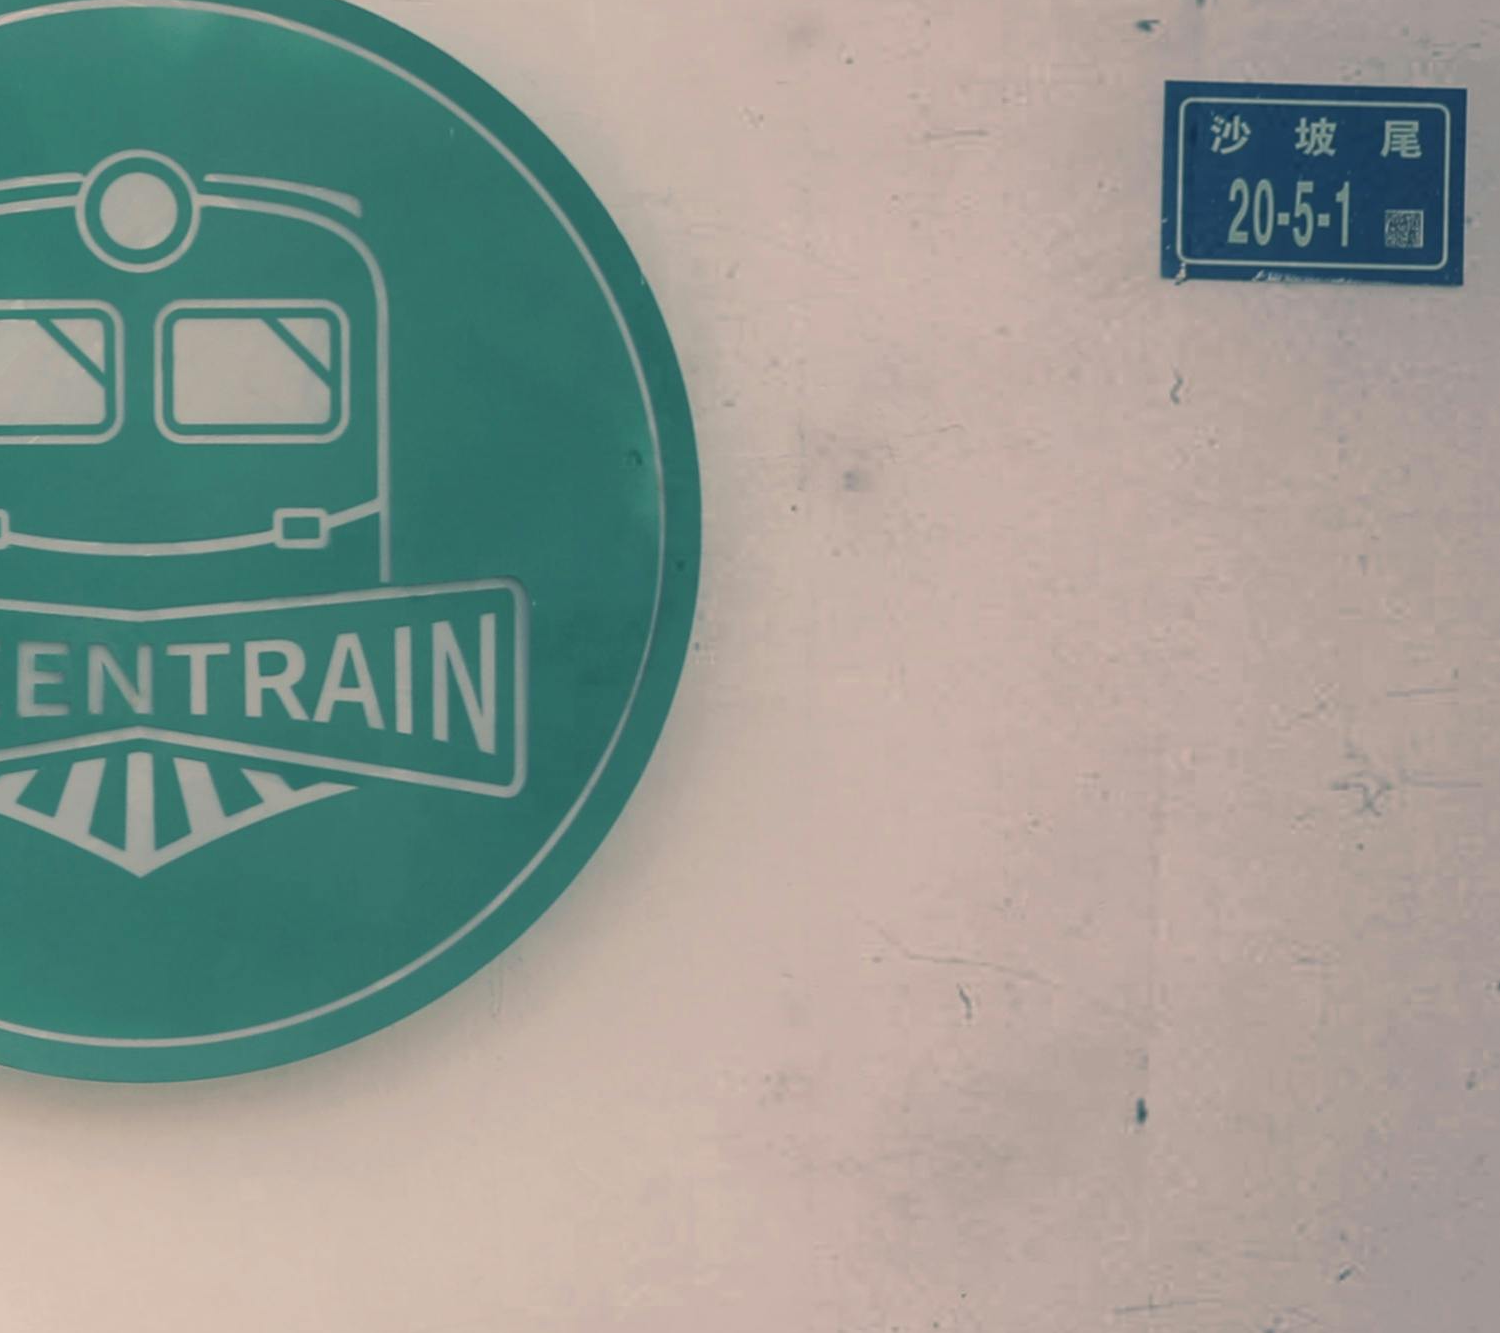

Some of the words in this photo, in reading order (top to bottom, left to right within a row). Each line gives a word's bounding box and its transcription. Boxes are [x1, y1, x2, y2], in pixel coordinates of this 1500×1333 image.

[1210, 115, 1422, 159] 沙坡尾
[1227, 177, 1351, 248] 20-5-1
